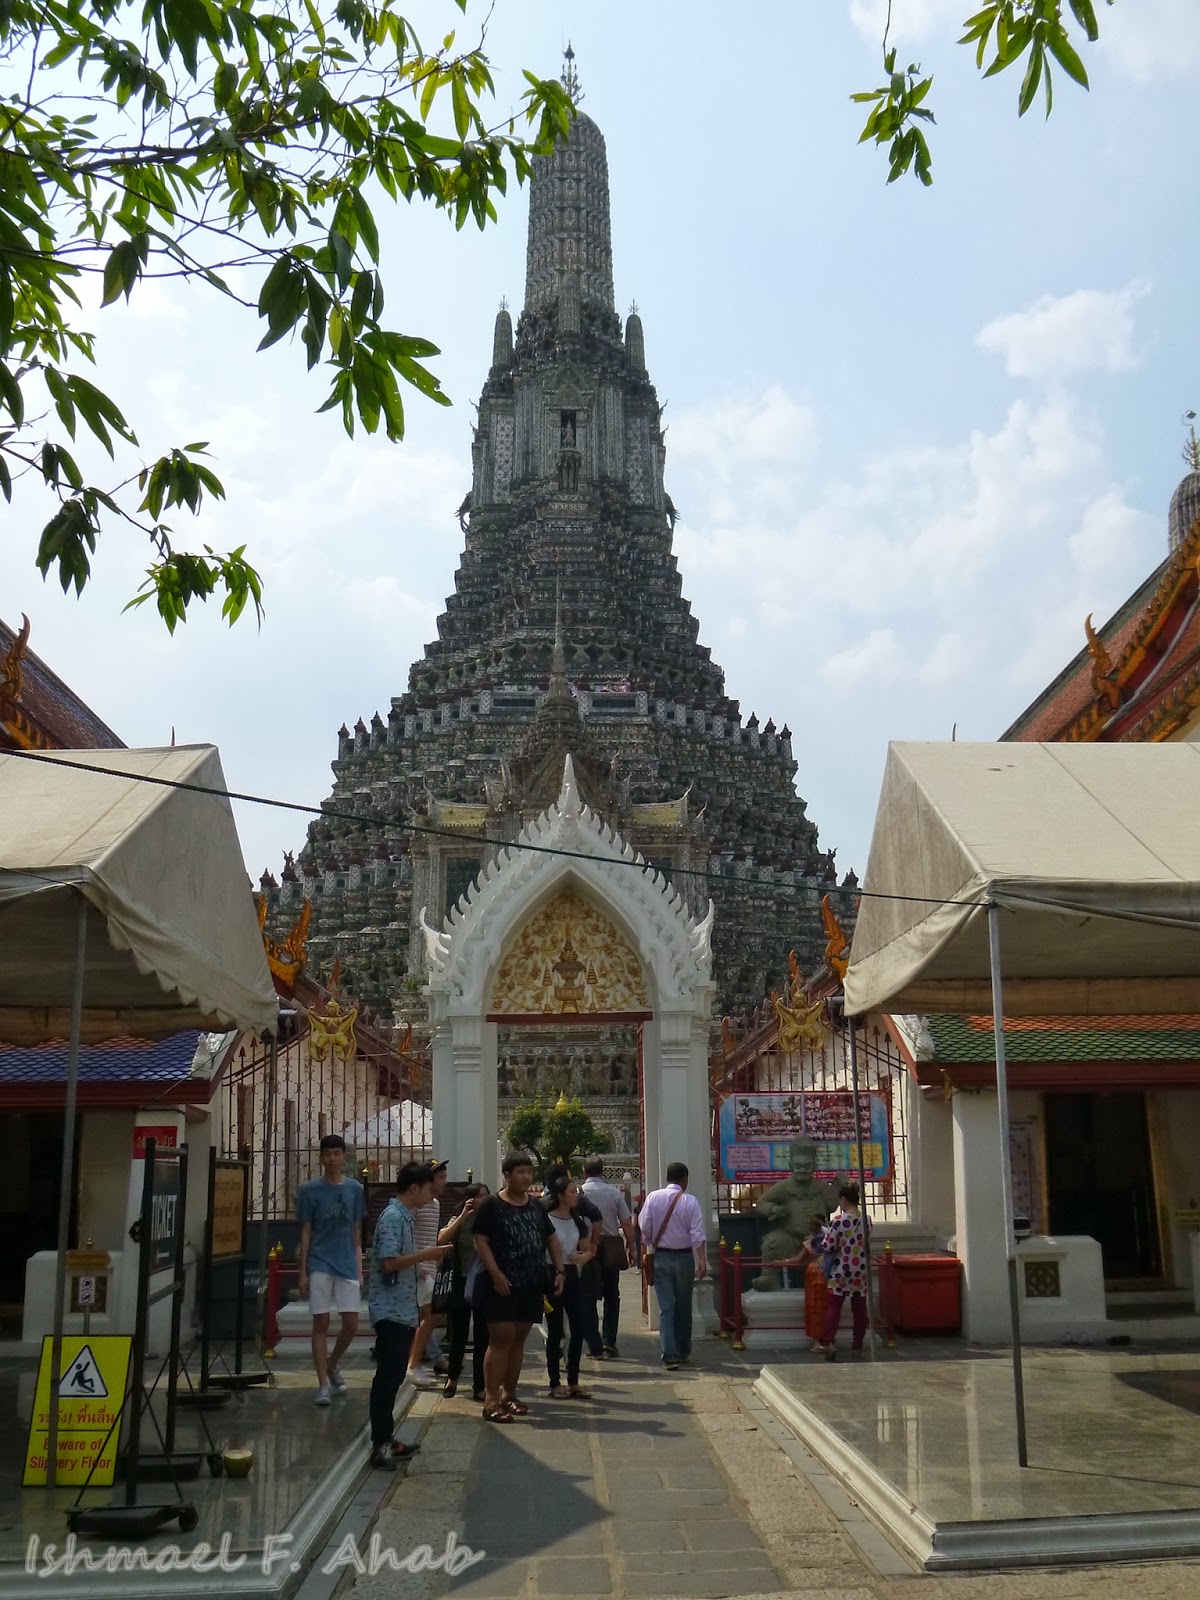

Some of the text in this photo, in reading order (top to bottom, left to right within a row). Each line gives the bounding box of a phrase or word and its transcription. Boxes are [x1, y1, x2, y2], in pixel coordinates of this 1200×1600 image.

[151, 1195, 177, 1240] TICKET
[44, 1438, 103, 1450] Bware of
[30, 1456, 111, 1471] Slipery Floor
